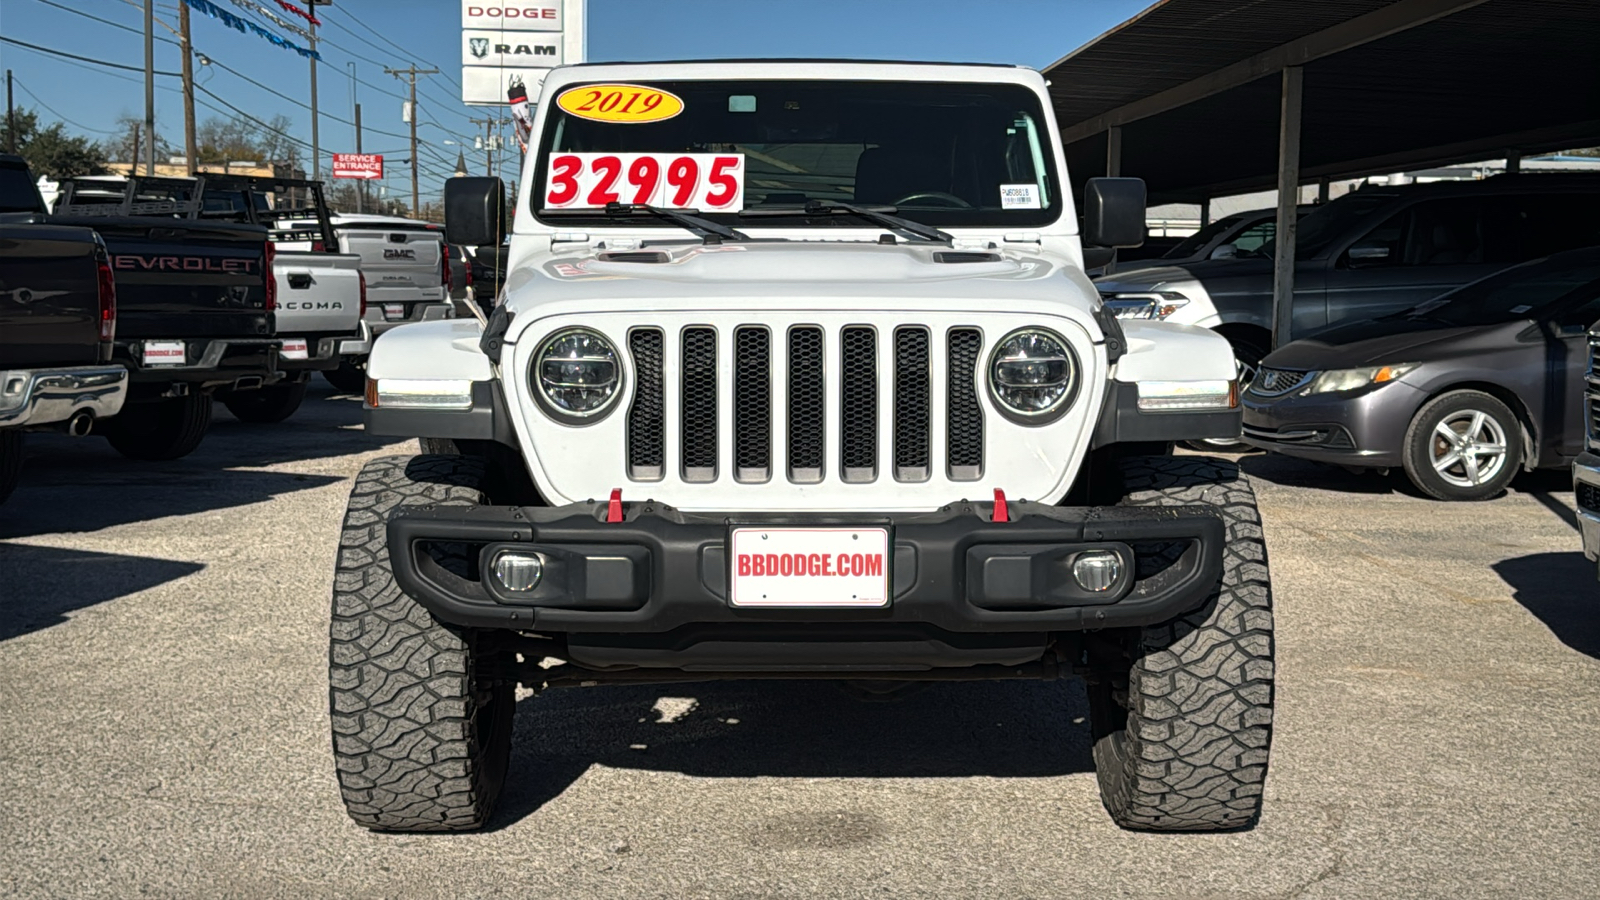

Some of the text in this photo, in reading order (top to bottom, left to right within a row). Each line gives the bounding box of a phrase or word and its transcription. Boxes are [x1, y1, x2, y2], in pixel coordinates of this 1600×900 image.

[468, 6, 557, 19] DODGE
[494, 44, 557, 56] RAM
[575, 90, 664, 114] 2019
[338, 154, 376, 162] SERVICE
[333, 162, 381, 170] ENTRANCE
[547, 154, 742, 208] 32995
[384, 249, 415, 260] GMC
[108, 255, 256, 272] EVROLET
[275, 302, 343, 310] ACOMA
[738, 553, 883, 577] BBDODGE.COM
